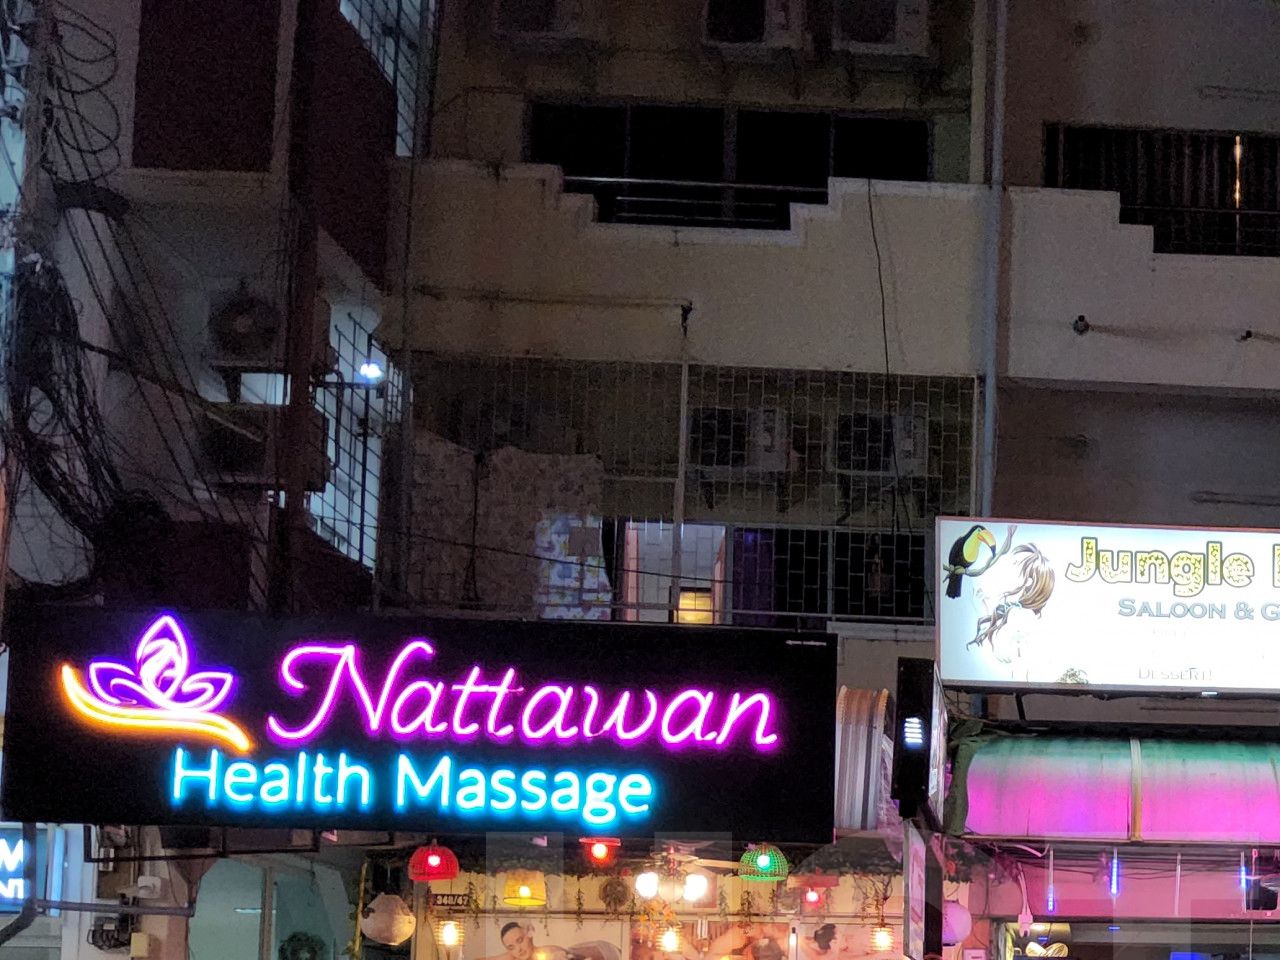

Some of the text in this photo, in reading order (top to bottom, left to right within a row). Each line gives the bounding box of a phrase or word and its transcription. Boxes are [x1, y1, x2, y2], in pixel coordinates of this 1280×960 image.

[1064, 537, 1256, 598] Jungle
[267, 640, 779, 747] Nattawan
[171, 748, 655, 825] Health Massage
